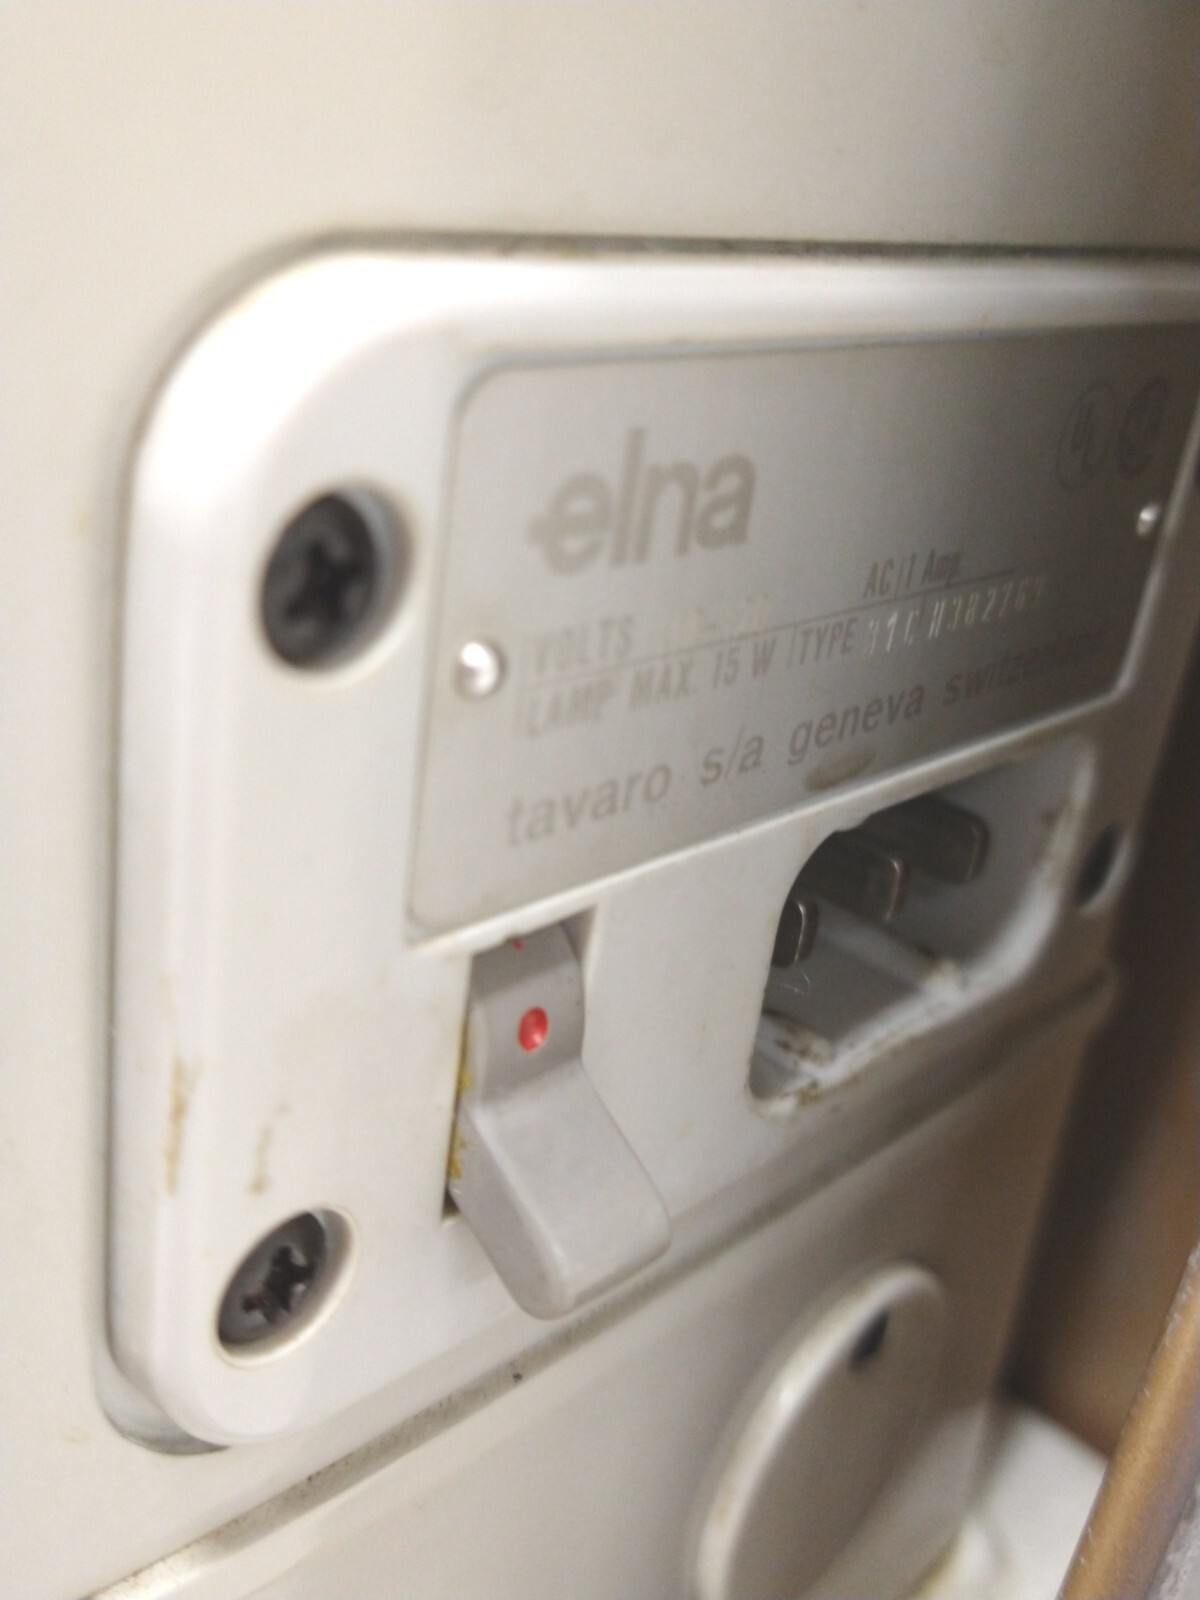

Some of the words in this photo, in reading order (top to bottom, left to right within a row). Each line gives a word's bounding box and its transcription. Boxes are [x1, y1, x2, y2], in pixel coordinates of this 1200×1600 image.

[527, 426, 757, 576] elna
[523, 613, 636, 677] VOLTS
[863, 557, 895, 598] AC
[713, 645, 742, 690] 15
[752, 635, 779, 680] W
[799, 613, 859, 666] TYPE
[507, 763, 672, 847] tavaro
[700, 723, 764, 789] s/a
[787, 683, 925, 767] geneva
